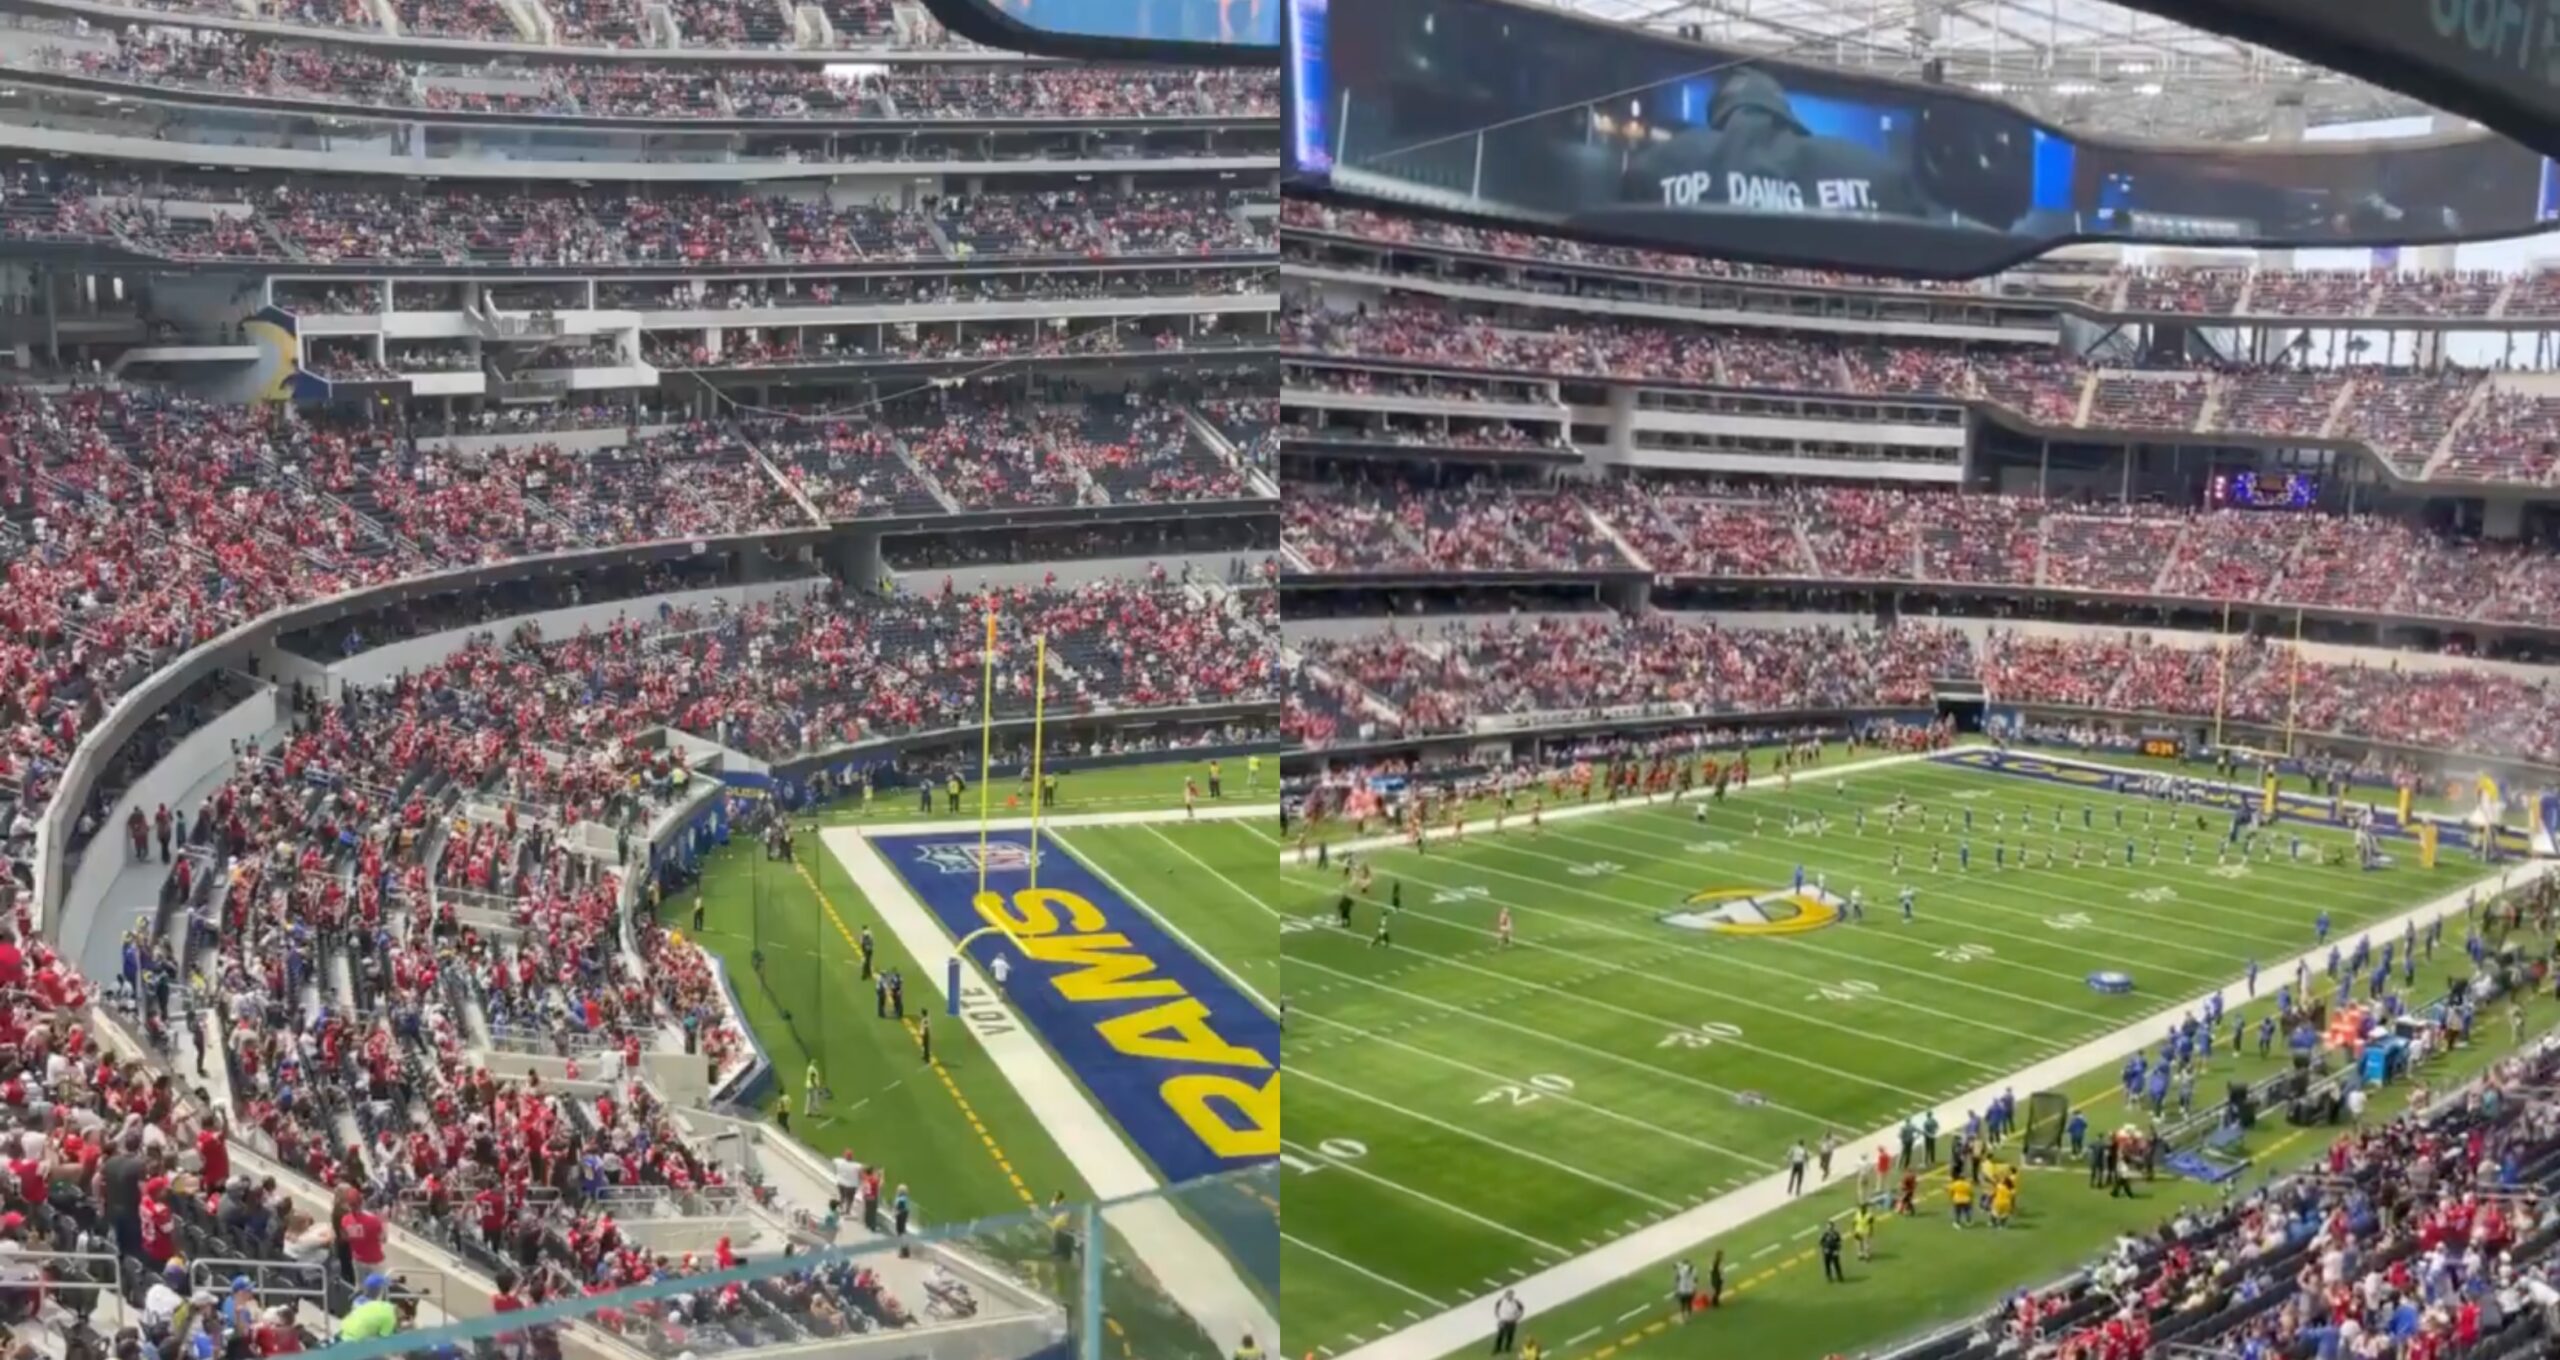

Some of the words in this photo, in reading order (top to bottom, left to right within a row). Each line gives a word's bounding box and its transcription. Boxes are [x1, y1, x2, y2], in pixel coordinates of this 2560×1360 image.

[1660, 171, 1712, 208] TOP
[1726, 171, 1804, 211] DAWG
[1816, 178, 1879, 209] ENT.
[973, 887, 1280, 1159] RAMS
[1656, 1021, 1743, 1048] 30
[1474, 1073, 1575, 1106] 20
